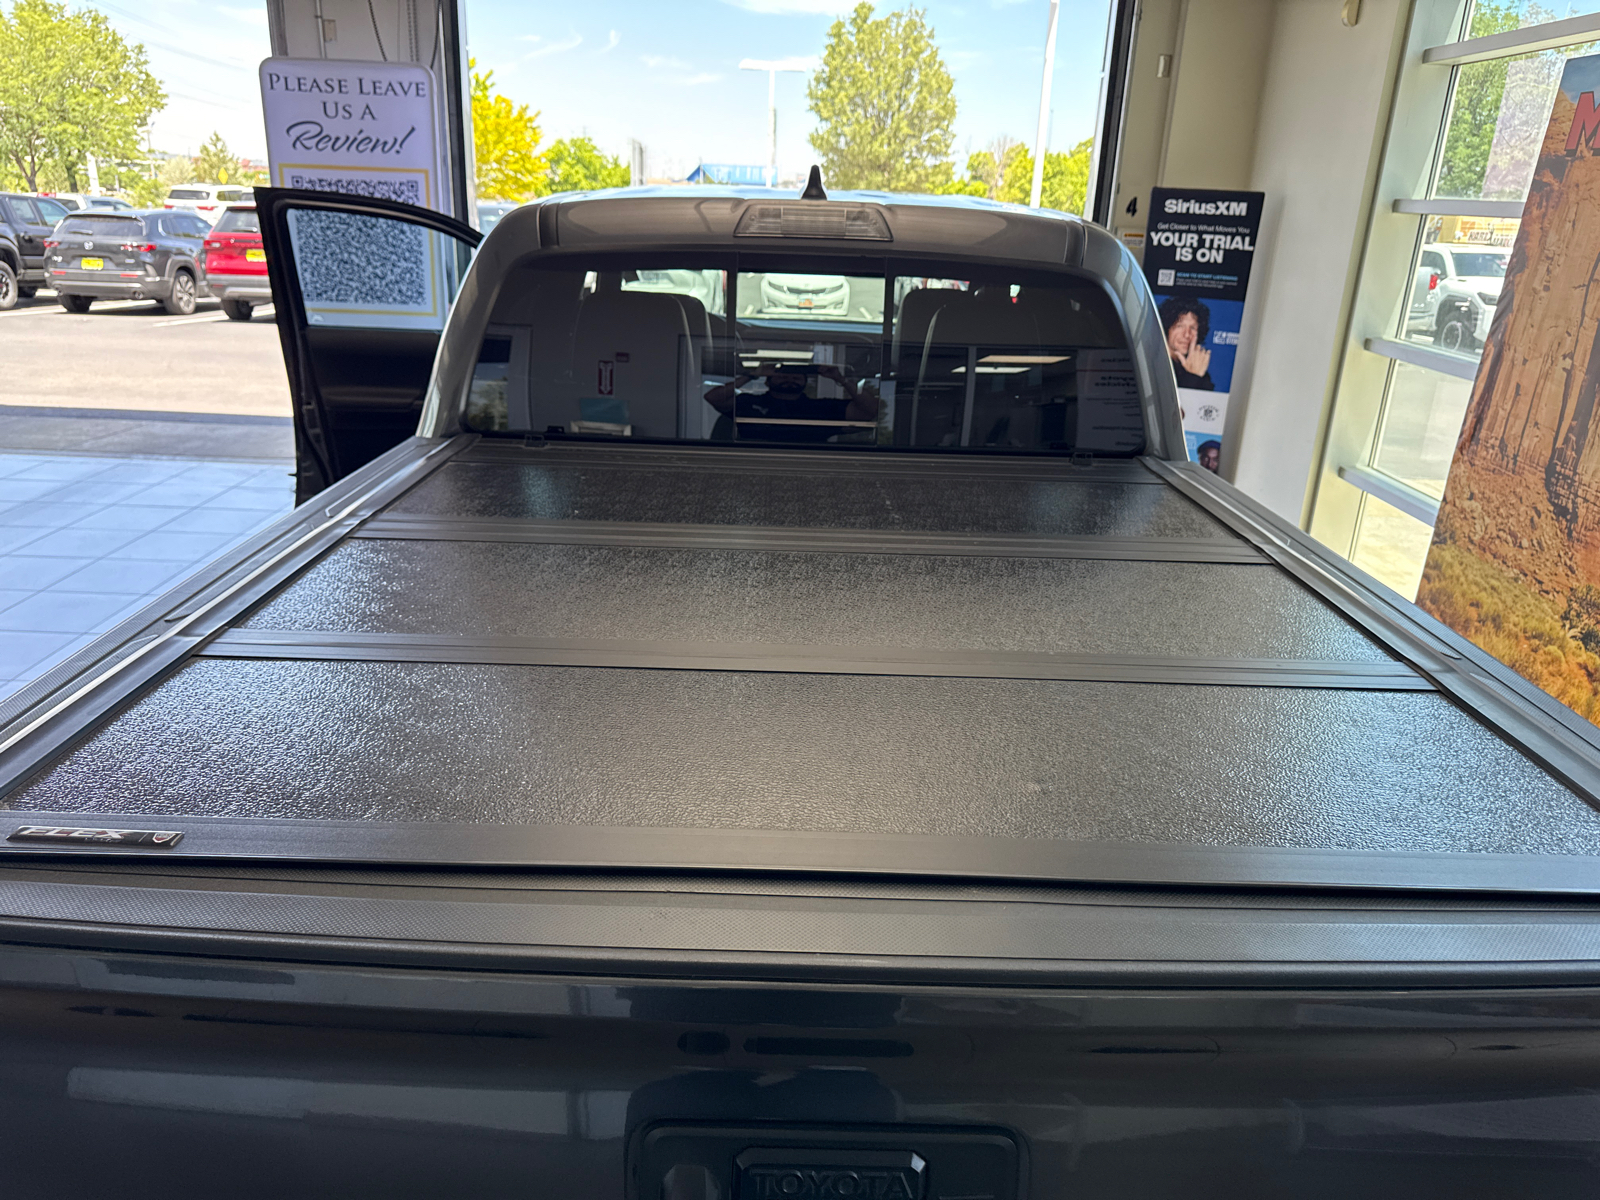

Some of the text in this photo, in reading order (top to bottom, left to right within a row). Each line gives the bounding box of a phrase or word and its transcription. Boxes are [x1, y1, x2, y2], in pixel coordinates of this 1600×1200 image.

[267, 72, 426, 98] PLEASE LEAVE
[322, 101, 378, 121] US A
[286, 120, 416, 154] Review!
[1125, 196, 1138, 217] 4
[1164, 198, 1248, 216] SiriusXM
[1157, 222, 1250, 234] Get Closer to What Moves You
[1150, 231, 1199, 248] YOUR
[1202, 234, 1254, 251] TRIAL
[1175, 247, 1224, 264] IS ON
[750, 1168, 914, 1200] TOYOTA
